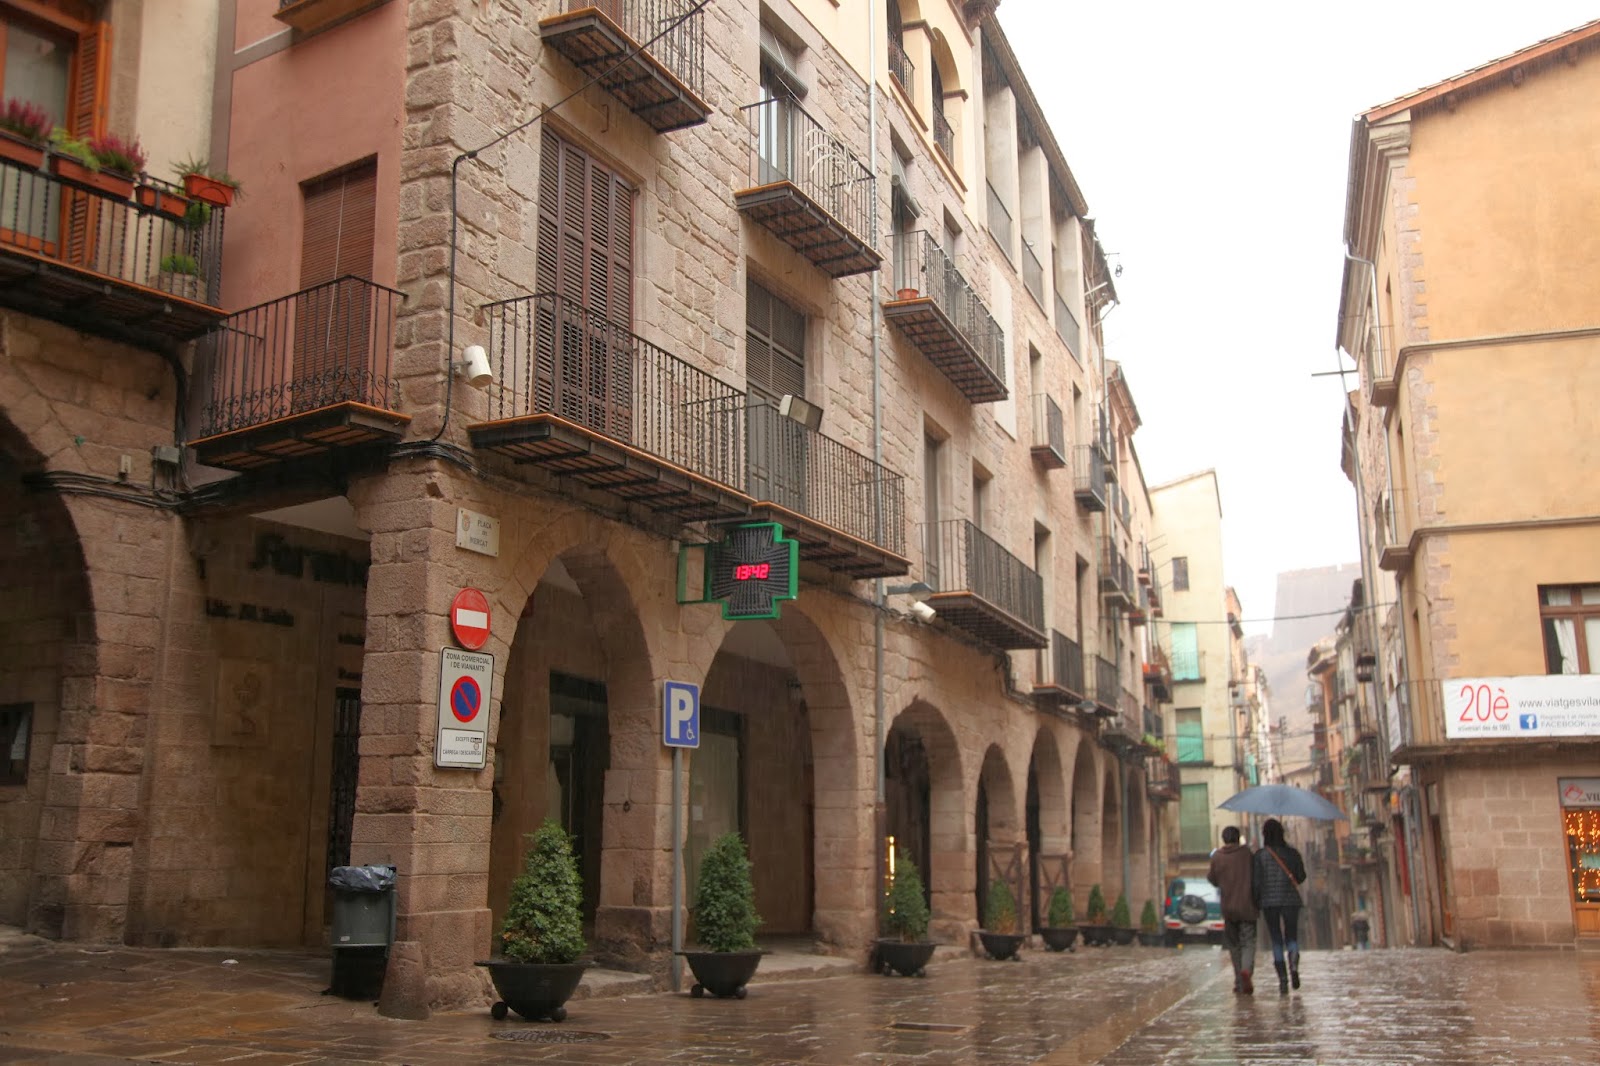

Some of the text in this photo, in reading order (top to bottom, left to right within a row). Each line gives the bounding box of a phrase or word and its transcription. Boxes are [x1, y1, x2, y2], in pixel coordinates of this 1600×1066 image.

[470, 536, 488, 547] MERCAT
[446, 652, 490, 665] ZONA COMERCIAL
[461, 662, 486, 672] VIANANTS
[1460, 684, 1509, 722] 20è
[1518, 696, 1600, 710] www.viatgesvila
[670, 688, 694, 739] P
